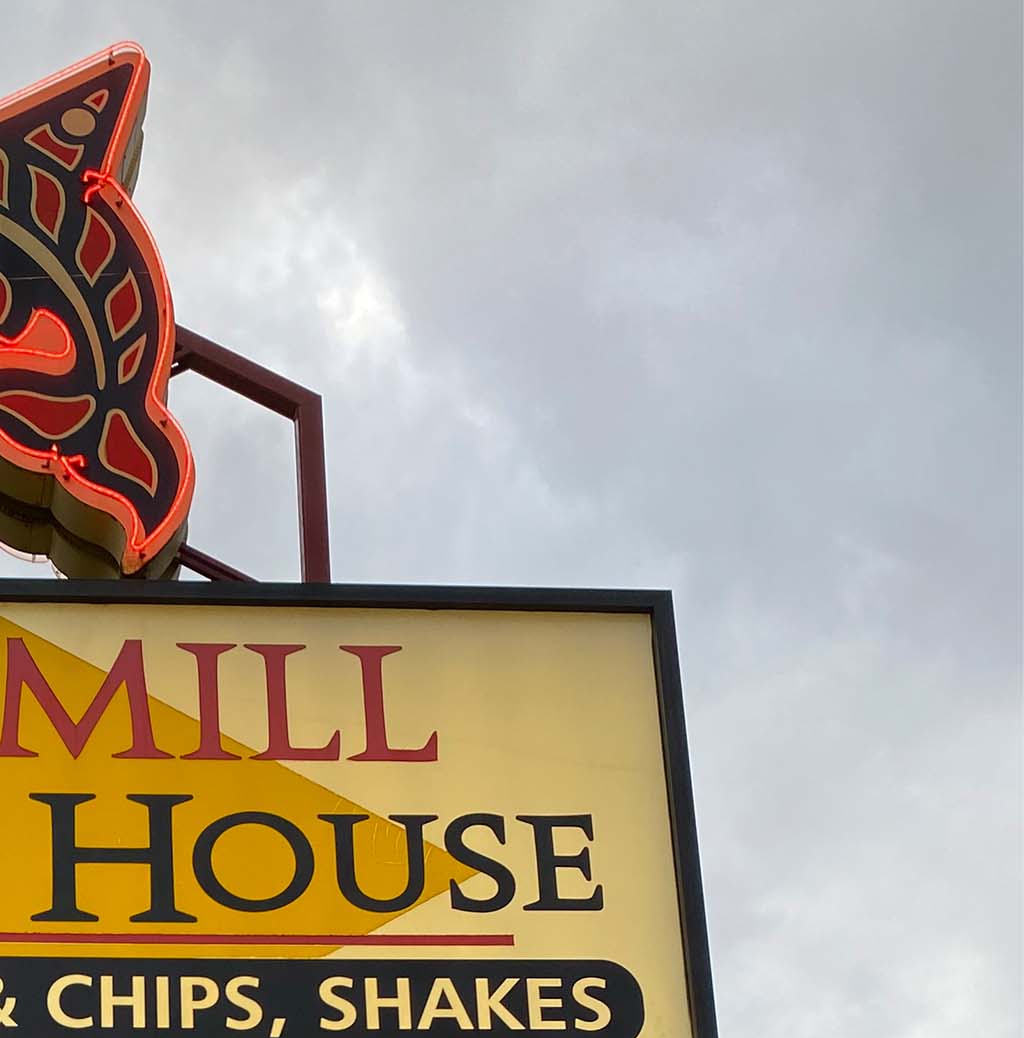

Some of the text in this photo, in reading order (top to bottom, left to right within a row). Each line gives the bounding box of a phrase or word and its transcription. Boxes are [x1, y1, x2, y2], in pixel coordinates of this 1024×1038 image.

[28, 792, 604, 924] HOUSE
[47, 974, 286, 1038] CHIPS,
[319, 976, 611, 1031] SHAKES
